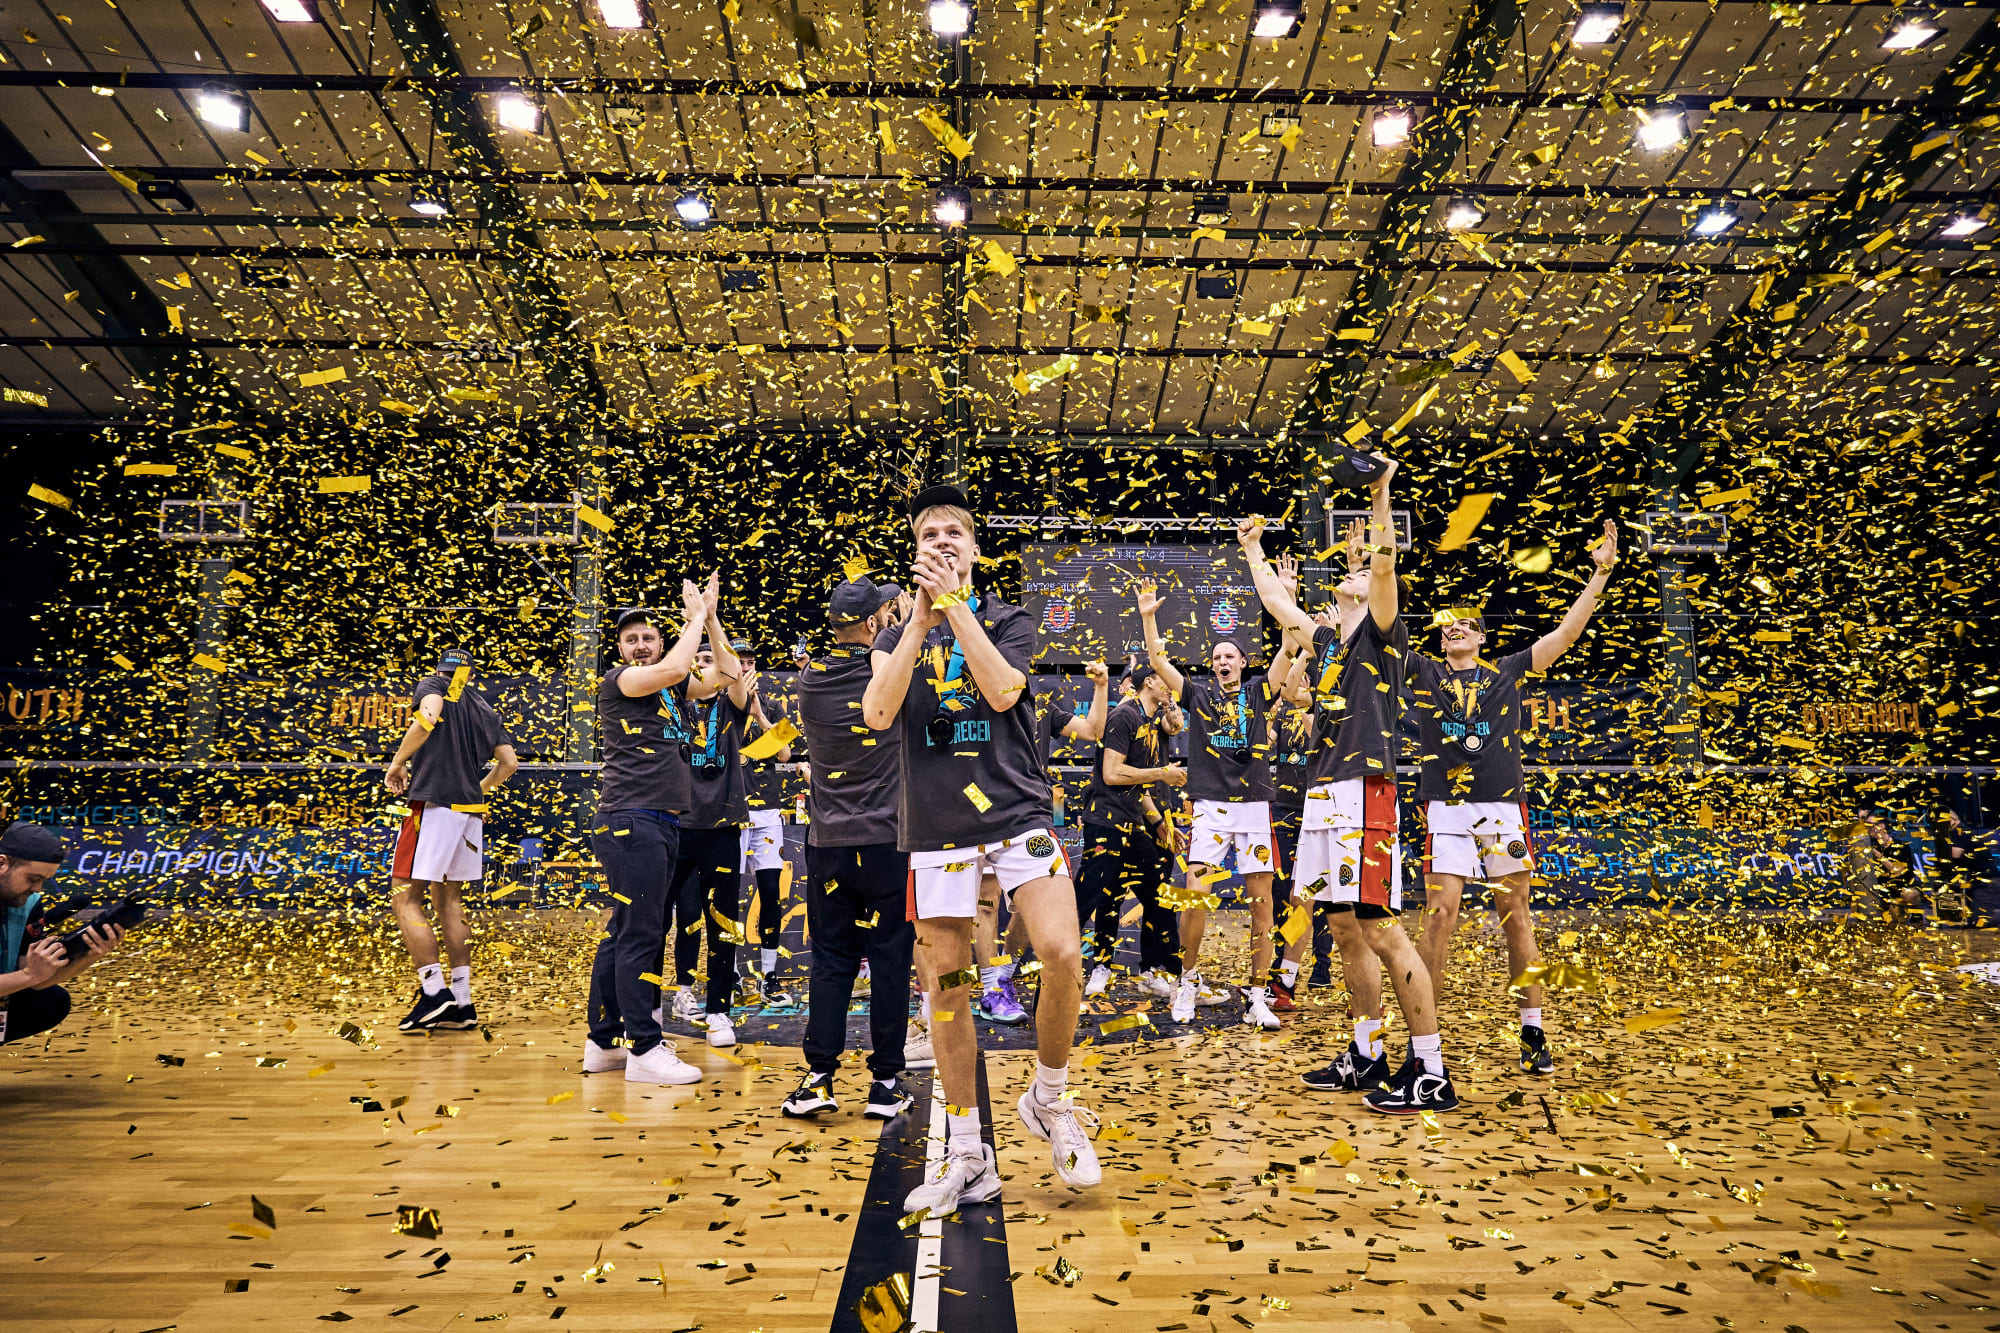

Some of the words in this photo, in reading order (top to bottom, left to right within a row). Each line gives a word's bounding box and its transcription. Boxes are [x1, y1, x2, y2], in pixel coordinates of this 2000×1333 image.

[0, 688, 84, 722] UTH
[926, 720, 991, 747] RECEN
[1442, 721, 1490, 738] DEBREN
[77, 850, 284, 875] CHAMPIONS
